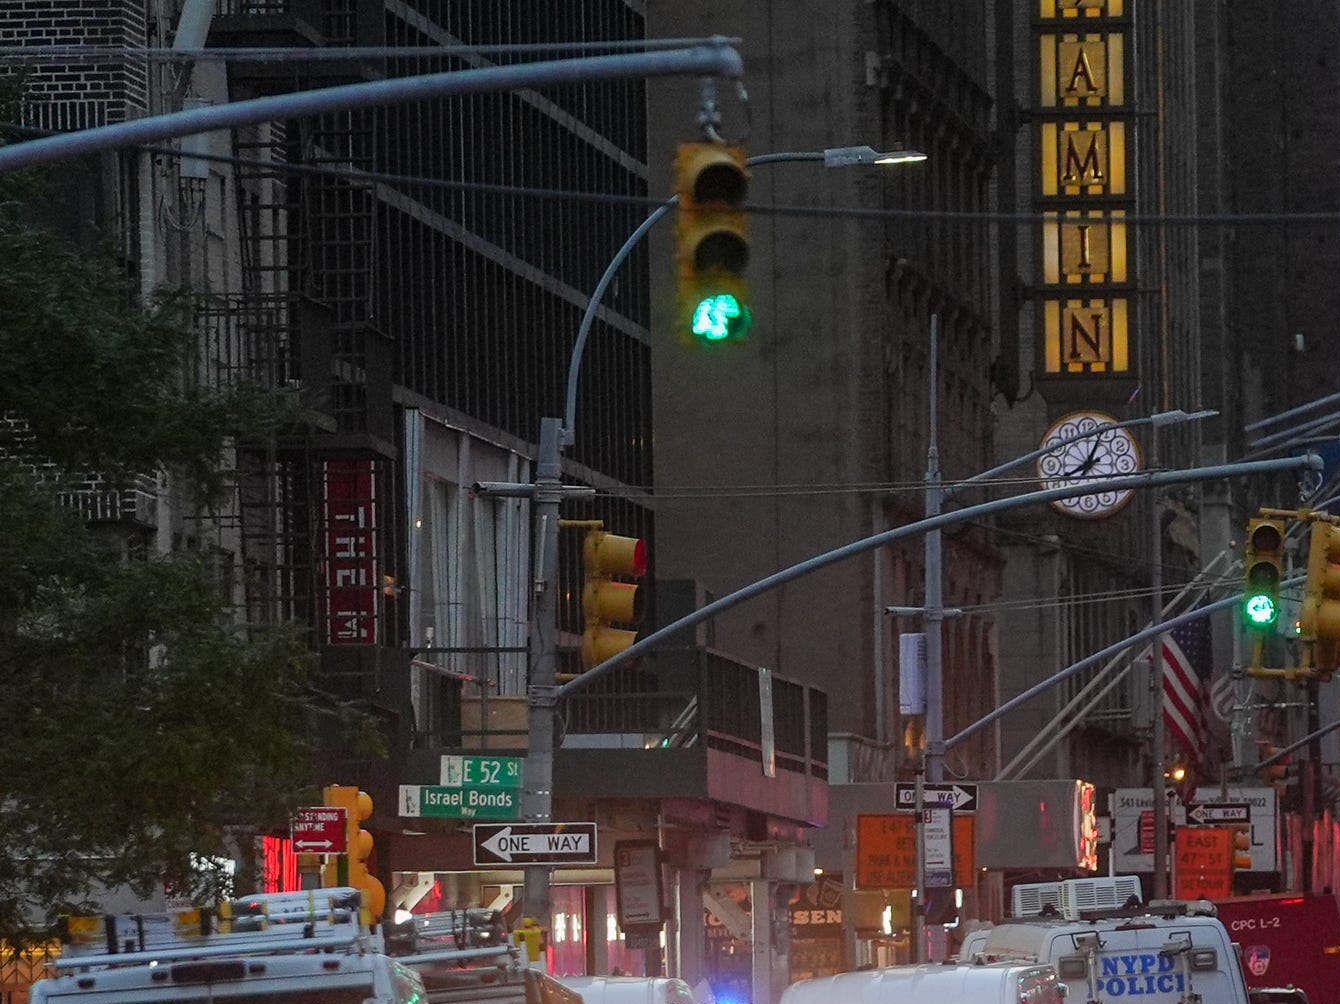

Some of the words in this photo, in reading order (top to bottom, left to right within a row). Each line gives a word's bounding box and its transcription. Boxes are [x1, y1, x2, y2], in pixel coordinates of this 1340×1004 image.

[1062, 0, 1104, 359] AMIN
[1116, 440, 1125, 452] 2
[1121, 459, 1130, 471] 3
[463, 760, 473, 783] E
[480, 760, 501, 784] 52
[507, 761, 518, 776] St
[425, 789, 463, 806] Israel
[469, 790, 513, 808] Bonds
[937, 791, 961, 802] WAY
[461, 807, 476, 817] Way
[1223, 809, 1243, 818] WAY
[498, 836, 531, 852] ONE
[548, 836, 583, 851] WAY
[1186, 836, 1219, 848] EAST
[1180, 878, 1225, 890] DETOUR
[789, 910, 842, 925] SEN
[1231, 919, 1256, 931] CPC
[1260, 916, 1281, 929] L-2
[1102, 953, 1175, 976] NYPD
